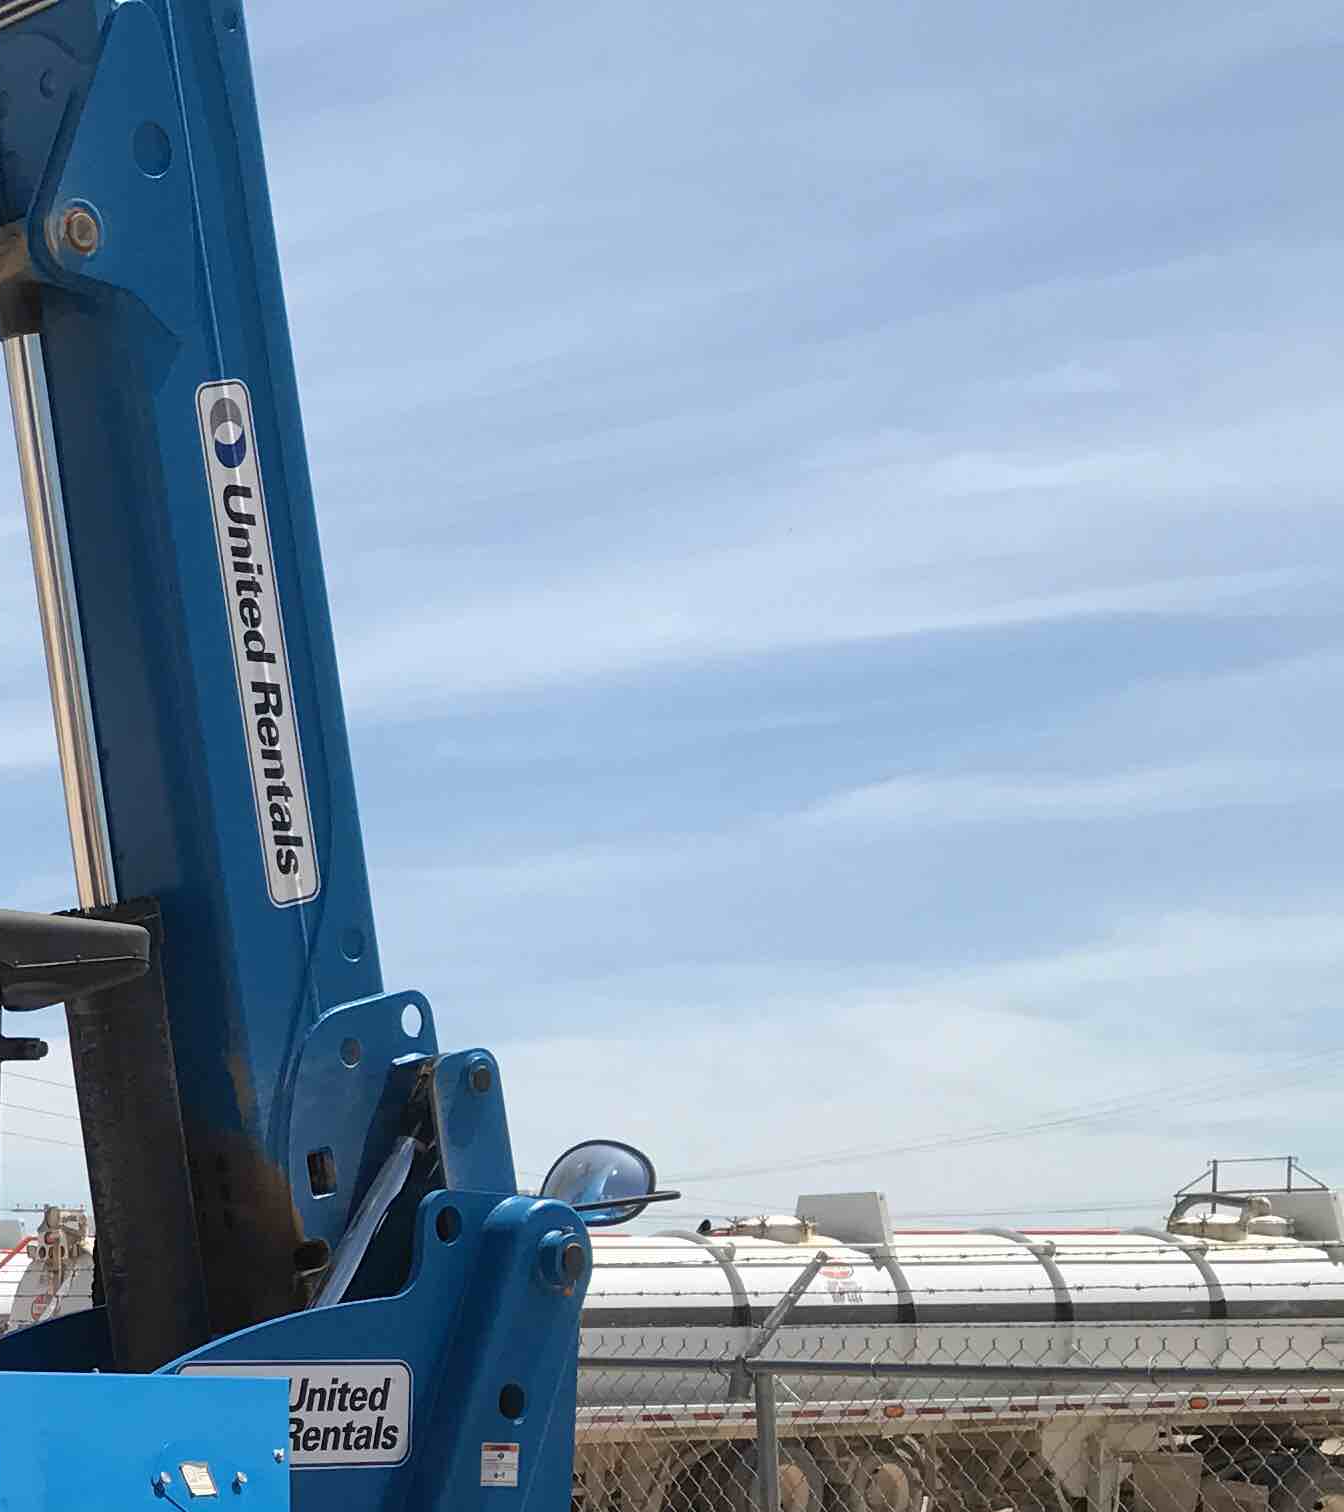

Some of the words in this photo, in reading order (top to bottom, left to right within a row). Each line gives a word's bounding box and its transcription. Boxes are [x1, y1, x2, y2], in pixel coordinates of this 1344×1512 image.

[222, 483, 277, 664] United
[251, 680, 304, 876] Rentals
[288, 1377, 392, 1413] United
[288, 1416, 400, 1451] Rentals
